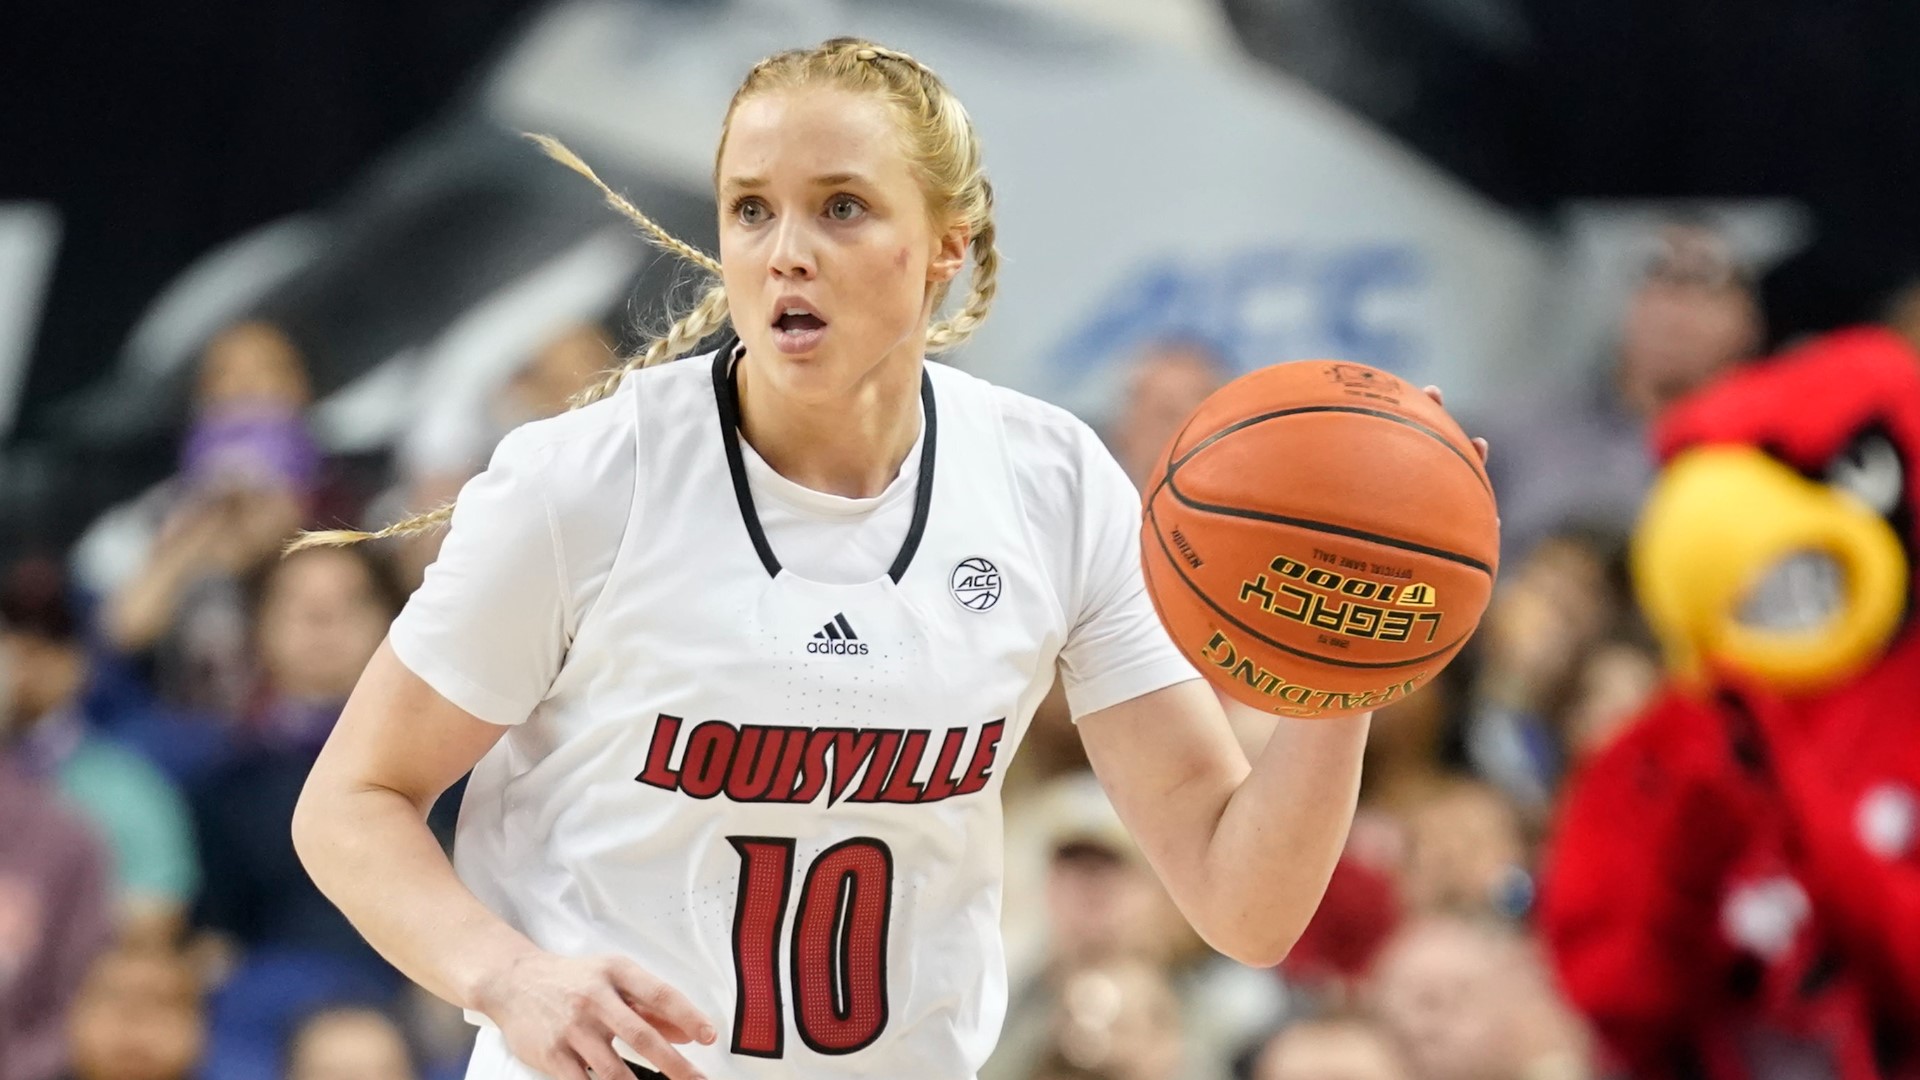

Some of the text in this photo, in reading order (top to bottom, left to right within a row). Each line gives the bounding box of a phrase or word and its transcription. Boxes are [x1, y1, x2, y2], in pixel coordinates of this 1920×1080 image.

[1312, 548, 1336, 565] BALL
[1339, 556, 1367, 572] GAME
[958, 573, 998, 588] ACC
[1268, 555, 1398, 603] 1000
[1238, 573, 1444, 643] LEGACY
[806, 640, 869, 655] adidas
[634, 713, 1007, 810] LOUISVILLE
[725, 835, 894, 1060] 10
